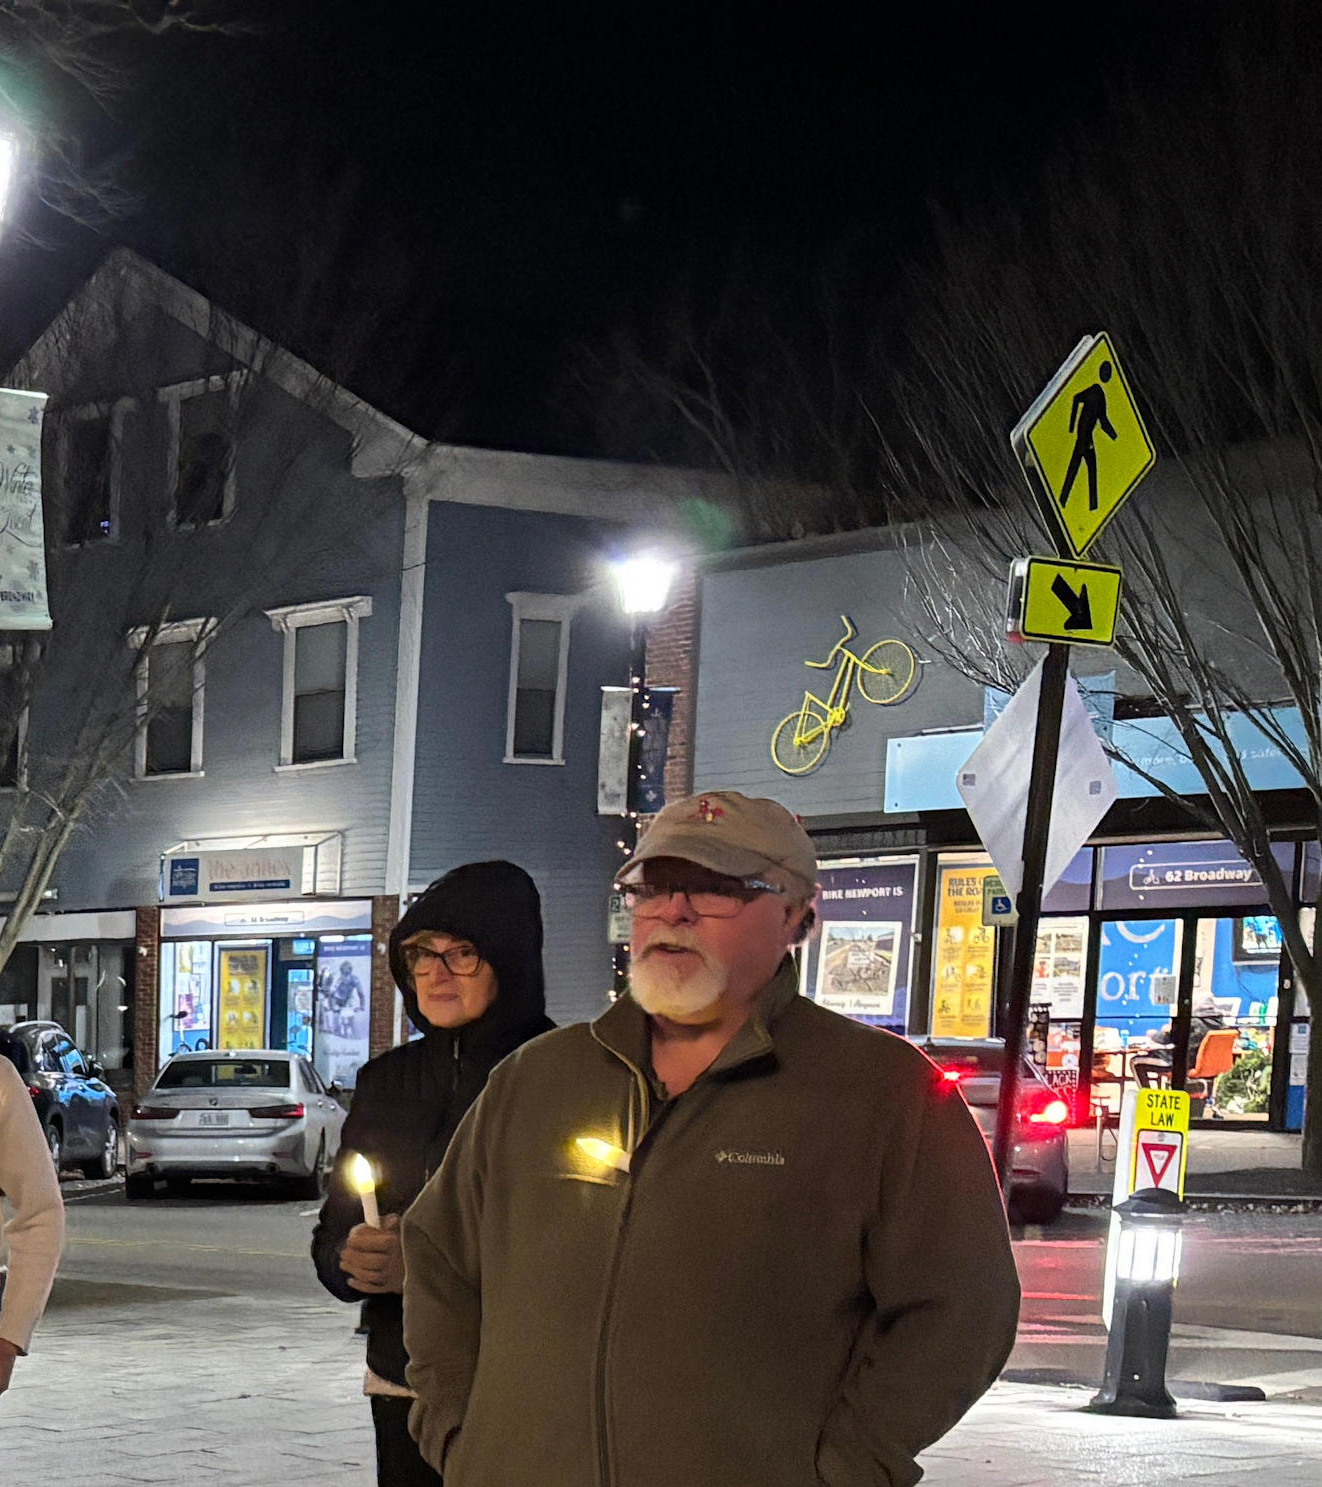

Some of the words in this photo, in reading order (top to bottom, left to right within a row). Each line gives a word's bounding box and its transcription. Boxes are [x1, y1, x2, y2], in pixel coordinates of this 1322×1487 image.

[1165, 870, 1182, 882] 62
[1184, 867, 1253, 882] Broadway
[822, 889, 843, 900] BIKE
[845, 887, 891, 899] NEWPORT
[893, 886, 903, 896] IS
[1146, 1094, 1181, 1110] STATE
[1151, 1111, 1174, 1127] LAW
[728, 1151, 785, 1166] Columbia
